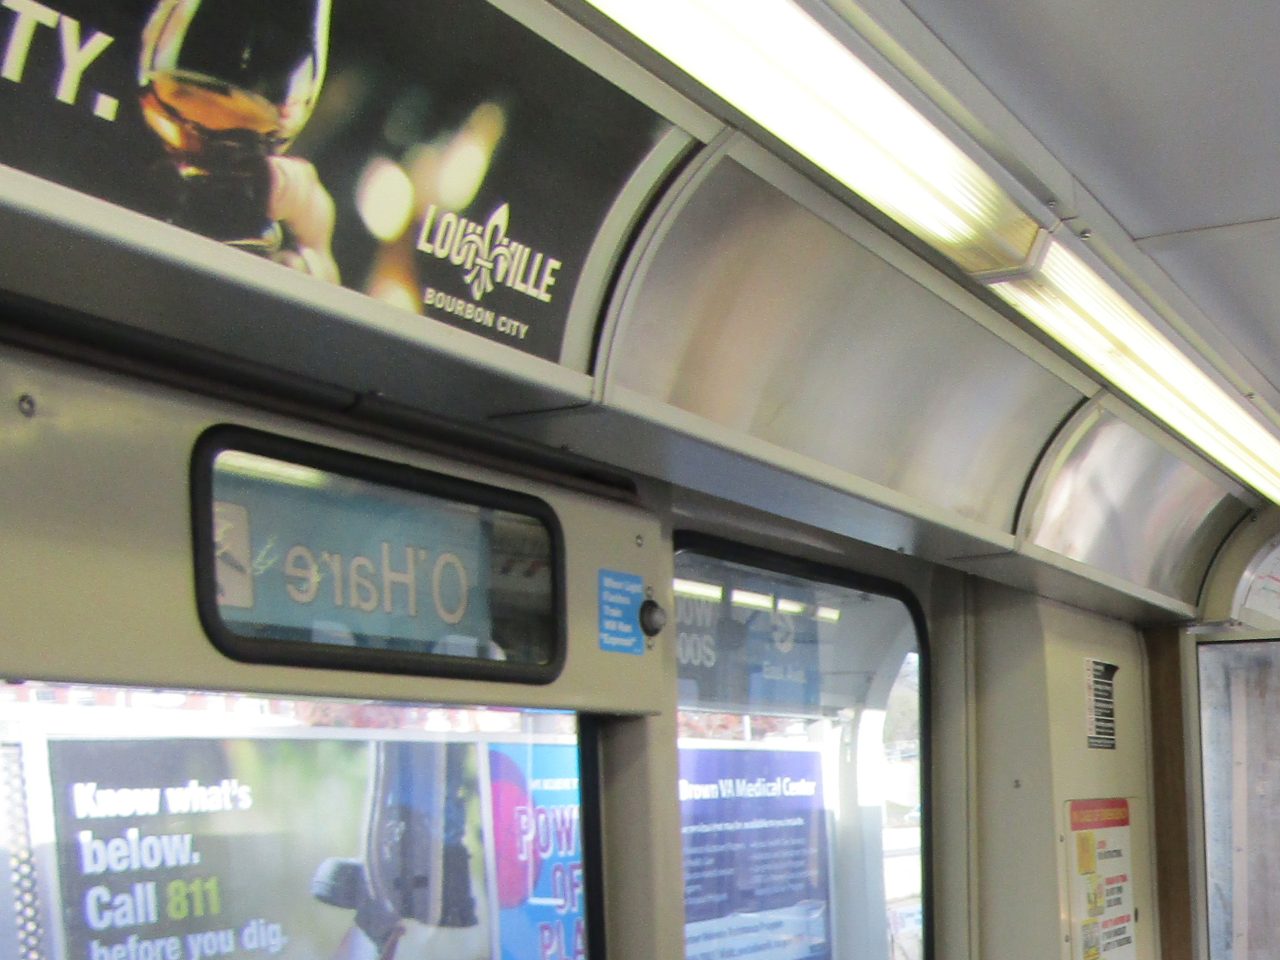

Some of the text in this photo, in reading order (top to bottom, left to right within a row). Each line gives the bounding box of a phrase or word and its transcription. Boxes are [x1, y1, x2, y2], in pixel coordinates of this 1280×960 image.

[0, 0, 120, 122] TY.
[424, 287, 529, 339] BOURBON CITY
[72, 779, 253, 819] Know what's
[678, 777, 817, 801] Brown VA Medical Center
[78, 827, 200, 874] below.
[85, 876, 221, 931] Call 811
[240, 919, 288, 953] dig.
